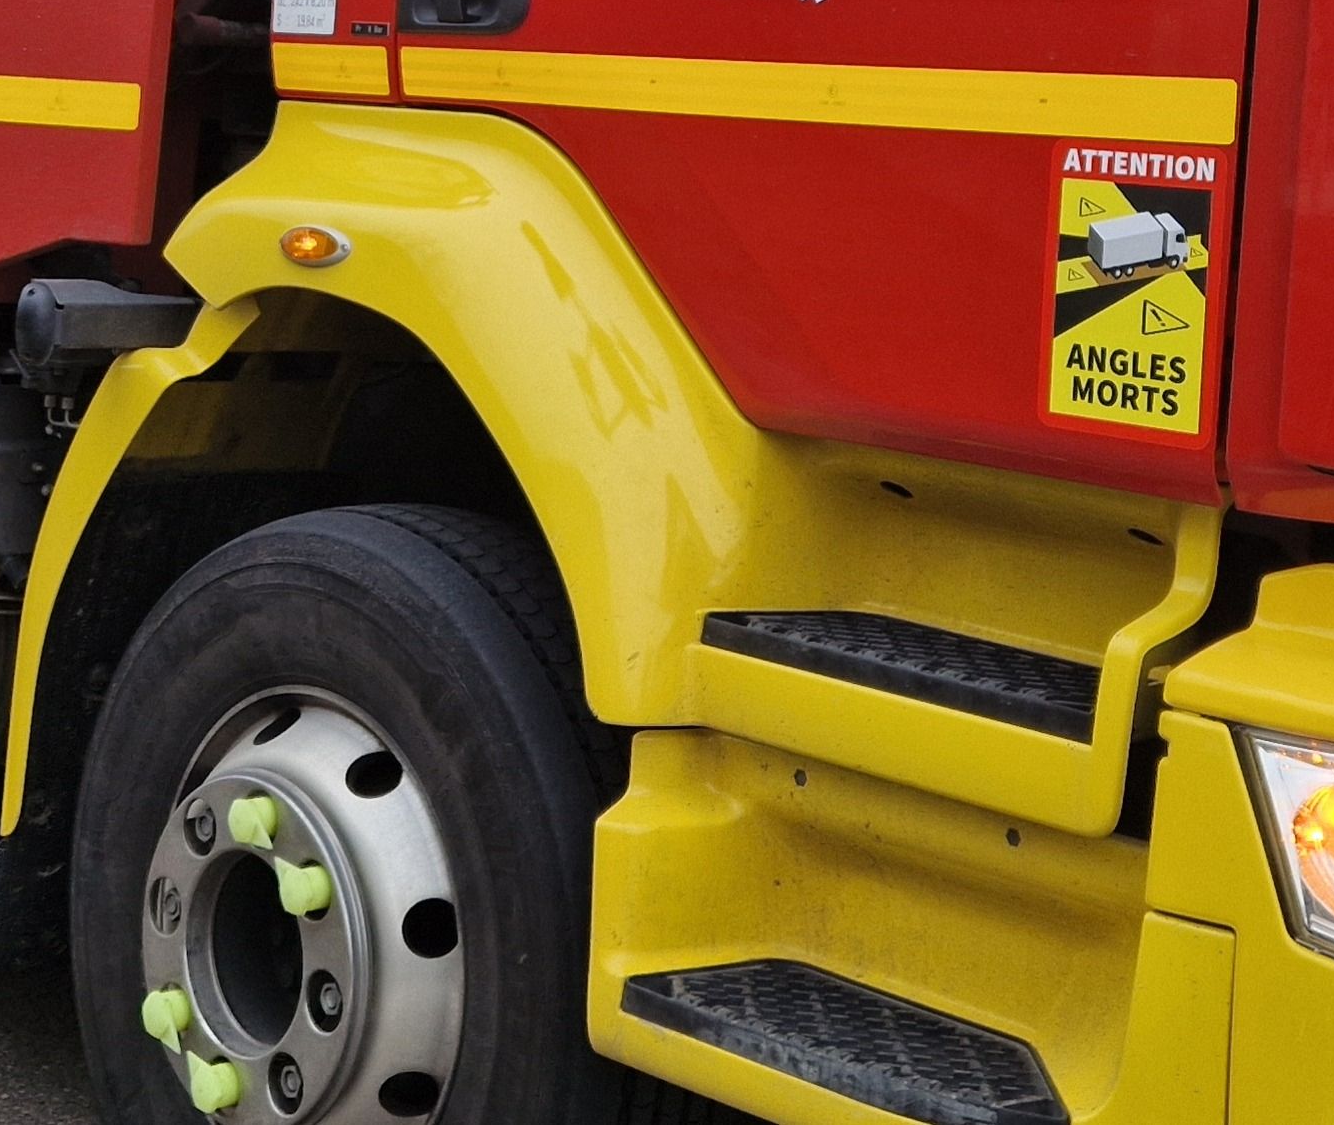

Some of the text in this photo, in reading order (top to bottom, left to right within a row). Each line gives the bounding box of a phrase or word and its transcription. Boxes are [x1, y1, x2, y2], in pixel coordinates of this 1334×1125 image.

[1064, 148, 1215, 181] ATTENTION
[1066, 343, 1187, 384] ANGLES
[1071, 375, 1179, 416] MORTS
